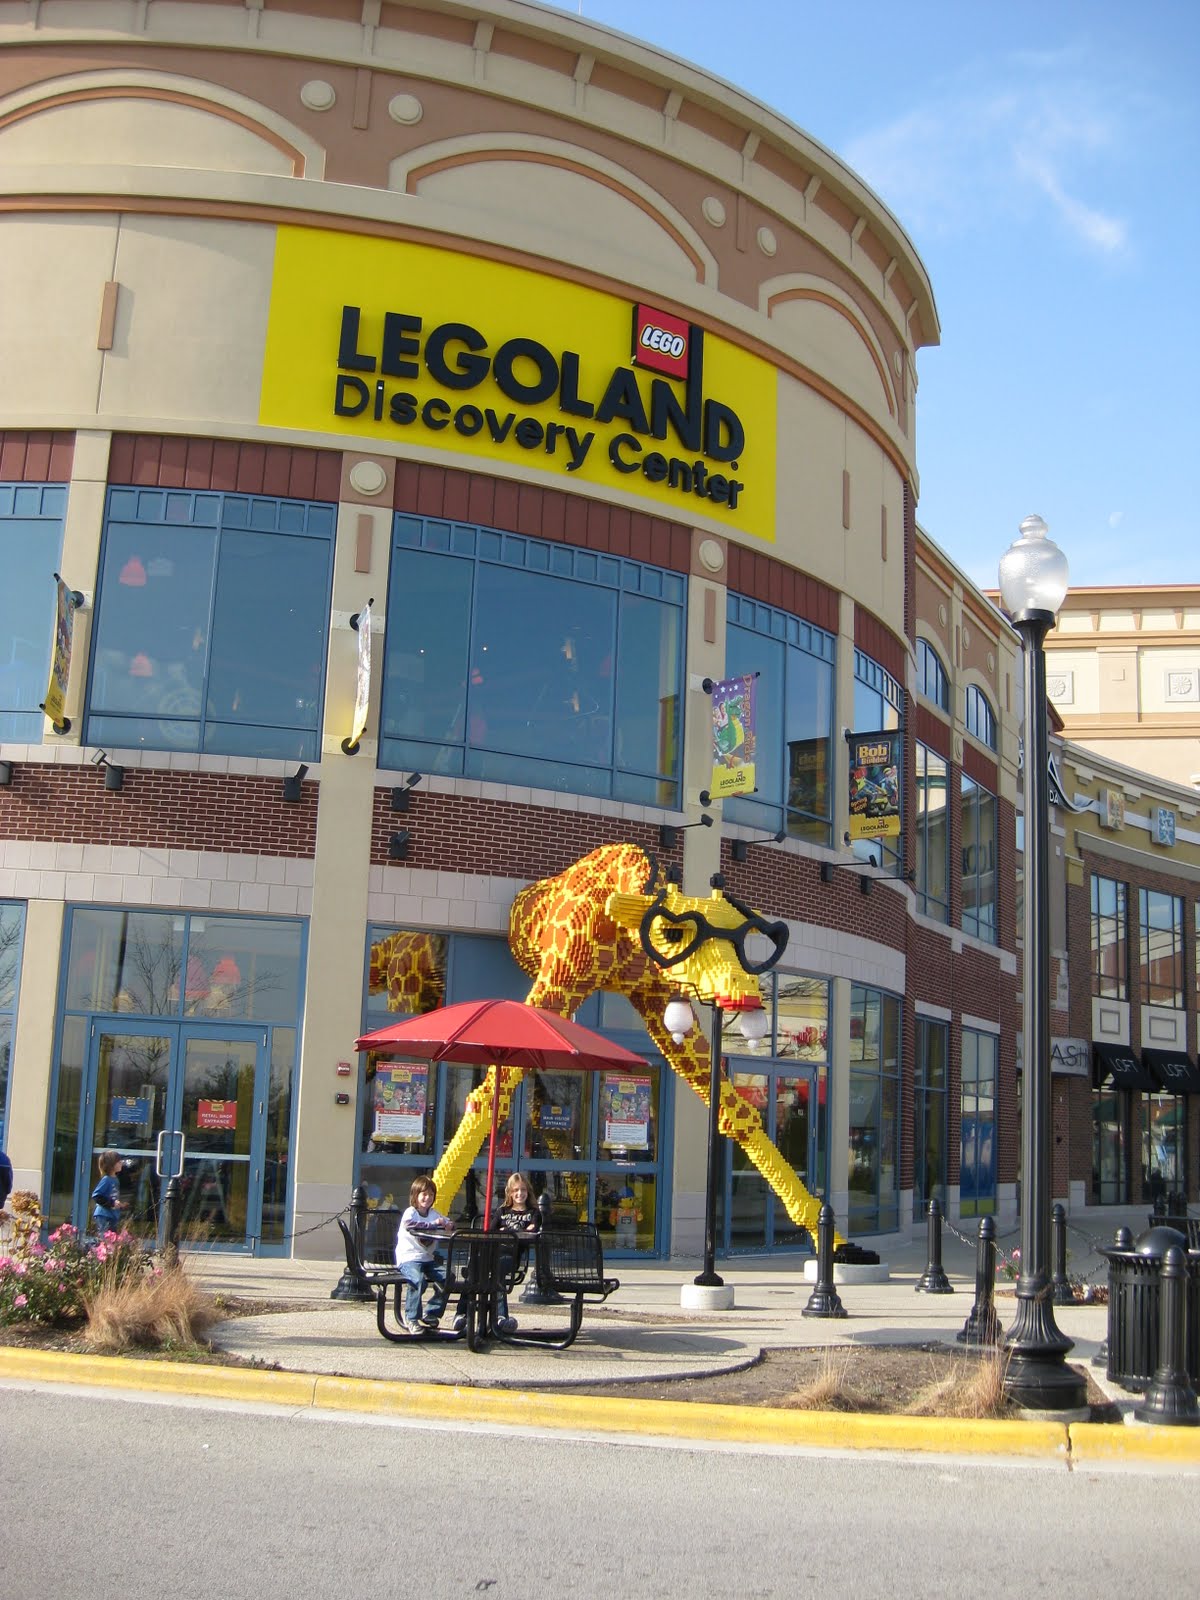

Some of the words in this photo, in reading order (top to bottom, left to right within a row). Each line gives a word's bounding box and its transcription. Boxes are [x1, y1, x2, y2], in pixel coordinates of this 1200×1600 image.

[641, 325, 685, 358] LEGO
[336, 305, 745, 464] LEGOLAND
[333, 374, 595, 471] Discovery
[608, 433, 744, 510] Center
[859, 744, 887, 758] Bob
[1110, 1057, 1139, 1073] LOFT
[1161, 1063, 1191, 1078] LOFT
